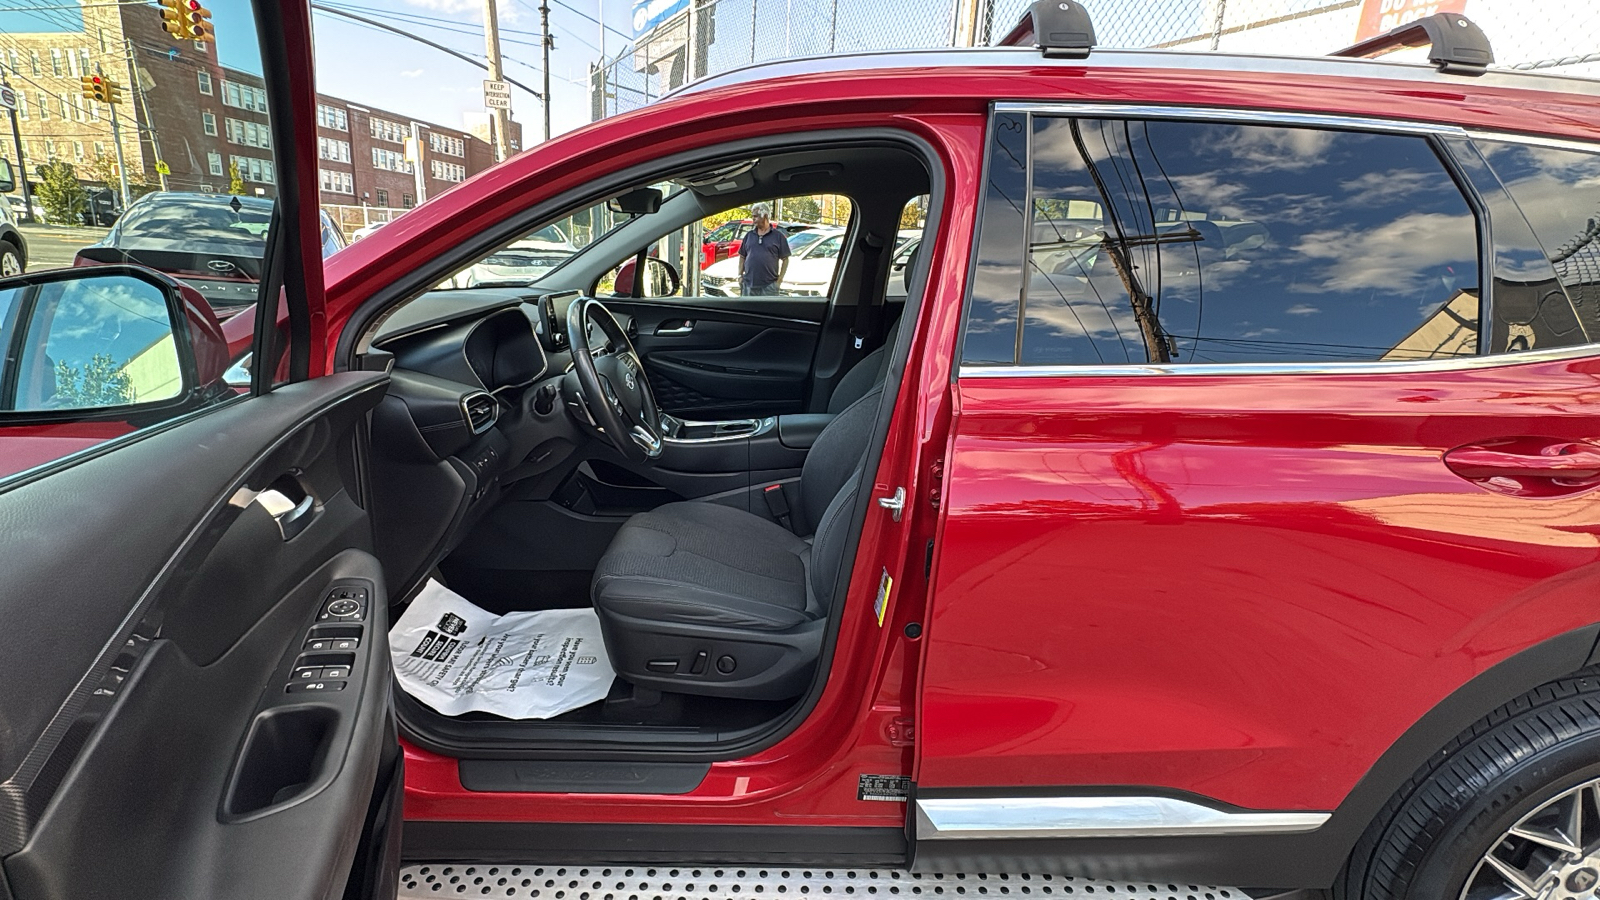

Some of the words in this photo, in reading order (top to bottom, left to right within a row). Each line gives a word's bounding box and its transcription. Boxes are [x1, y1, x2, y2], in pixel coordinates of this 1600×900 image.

[416, 637, 432, 654] COUNT
[455, 641, 470, 655] FLOOR
[495, 641, 505, 653] your
[532, 638, 541, 649] your
[556, 637, 574, 664] inspection
[572, 637, 584, 650] Have
[568, 651, 576, 660] you
[435, 664, 452, 680] SAFETY
[556, 673, 567, 687] your
